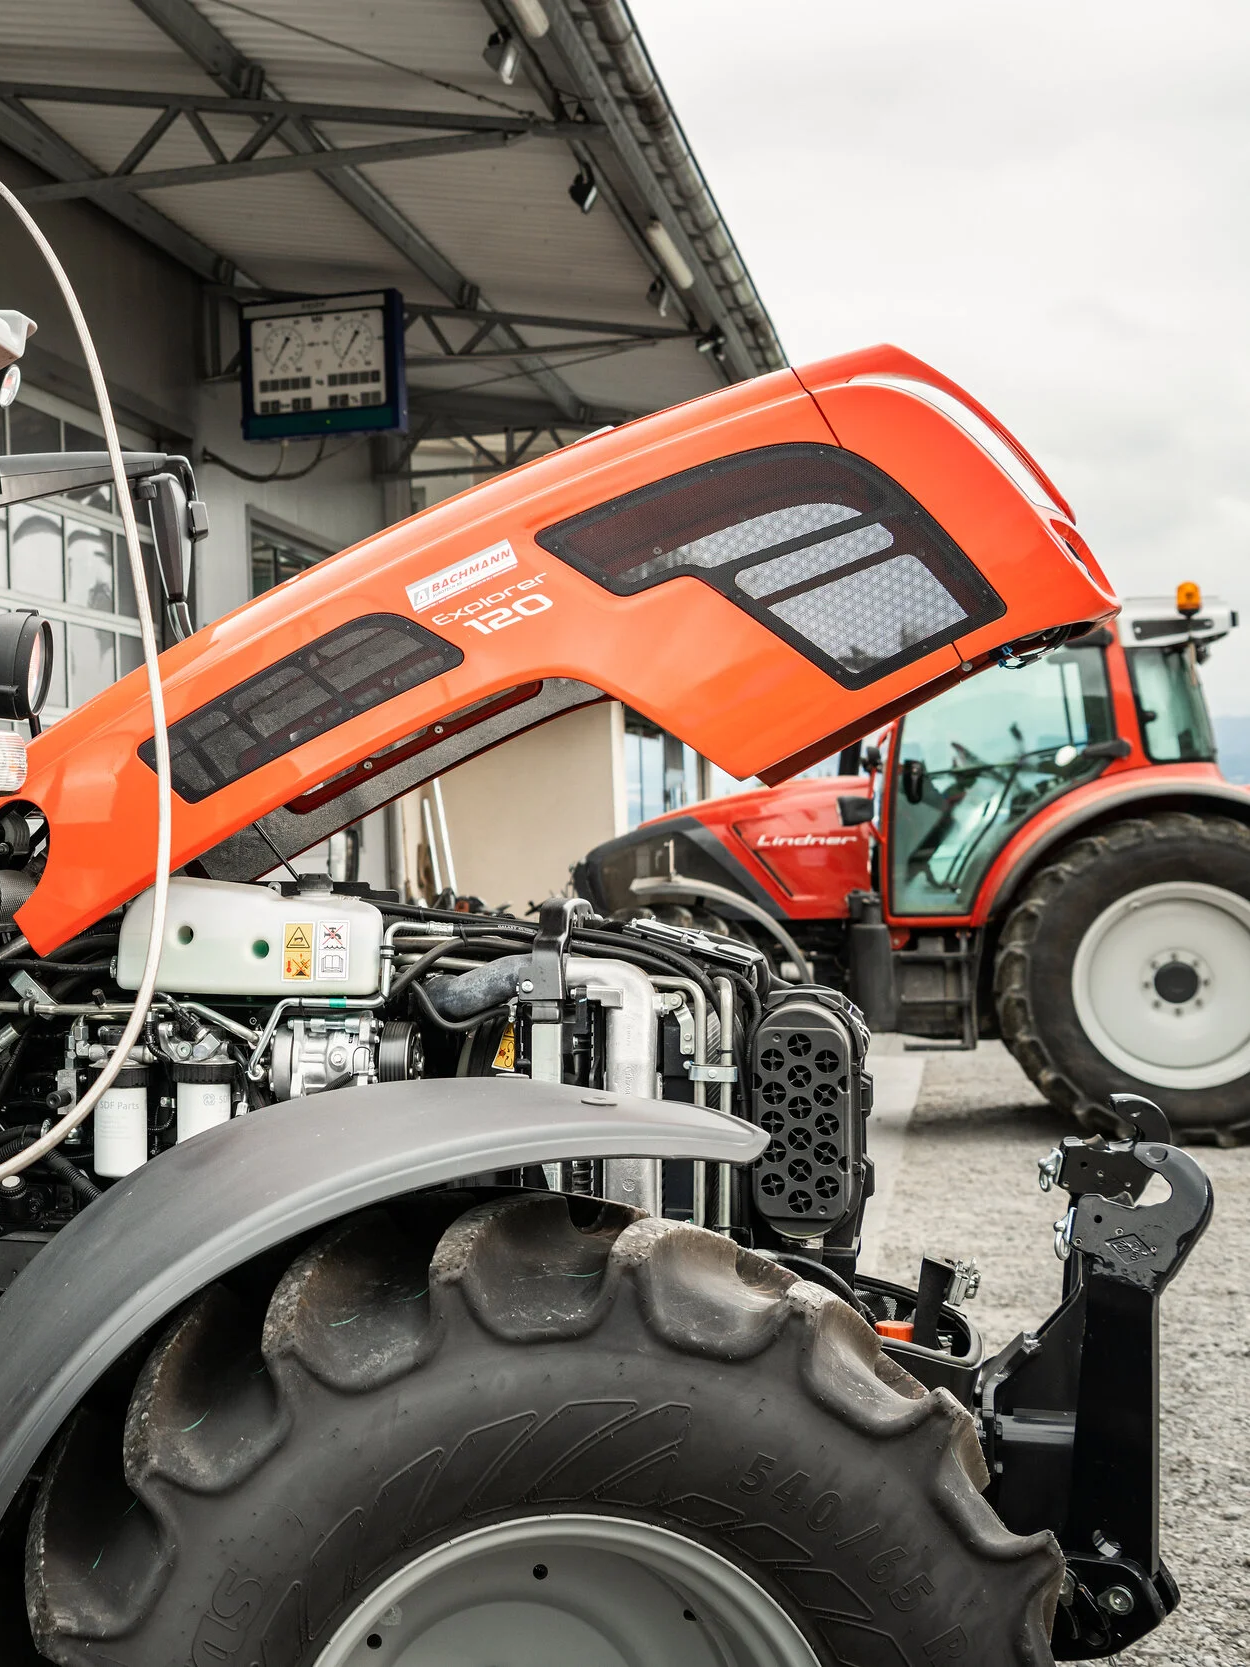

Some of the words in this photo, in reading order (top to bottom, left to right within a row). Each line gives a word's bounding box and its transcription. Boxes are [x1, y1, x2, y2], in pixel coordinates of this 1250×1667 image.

[432, 549, 510, 592] BACHMANN
[432, 572, 546, 625] Explorer
[463, 594, 553, 634] 120
[757, 834, 857, 846] Lindner
[118, 1102, 139, 1110] Parts
[738, 1452, 935, 1612] 540/65
